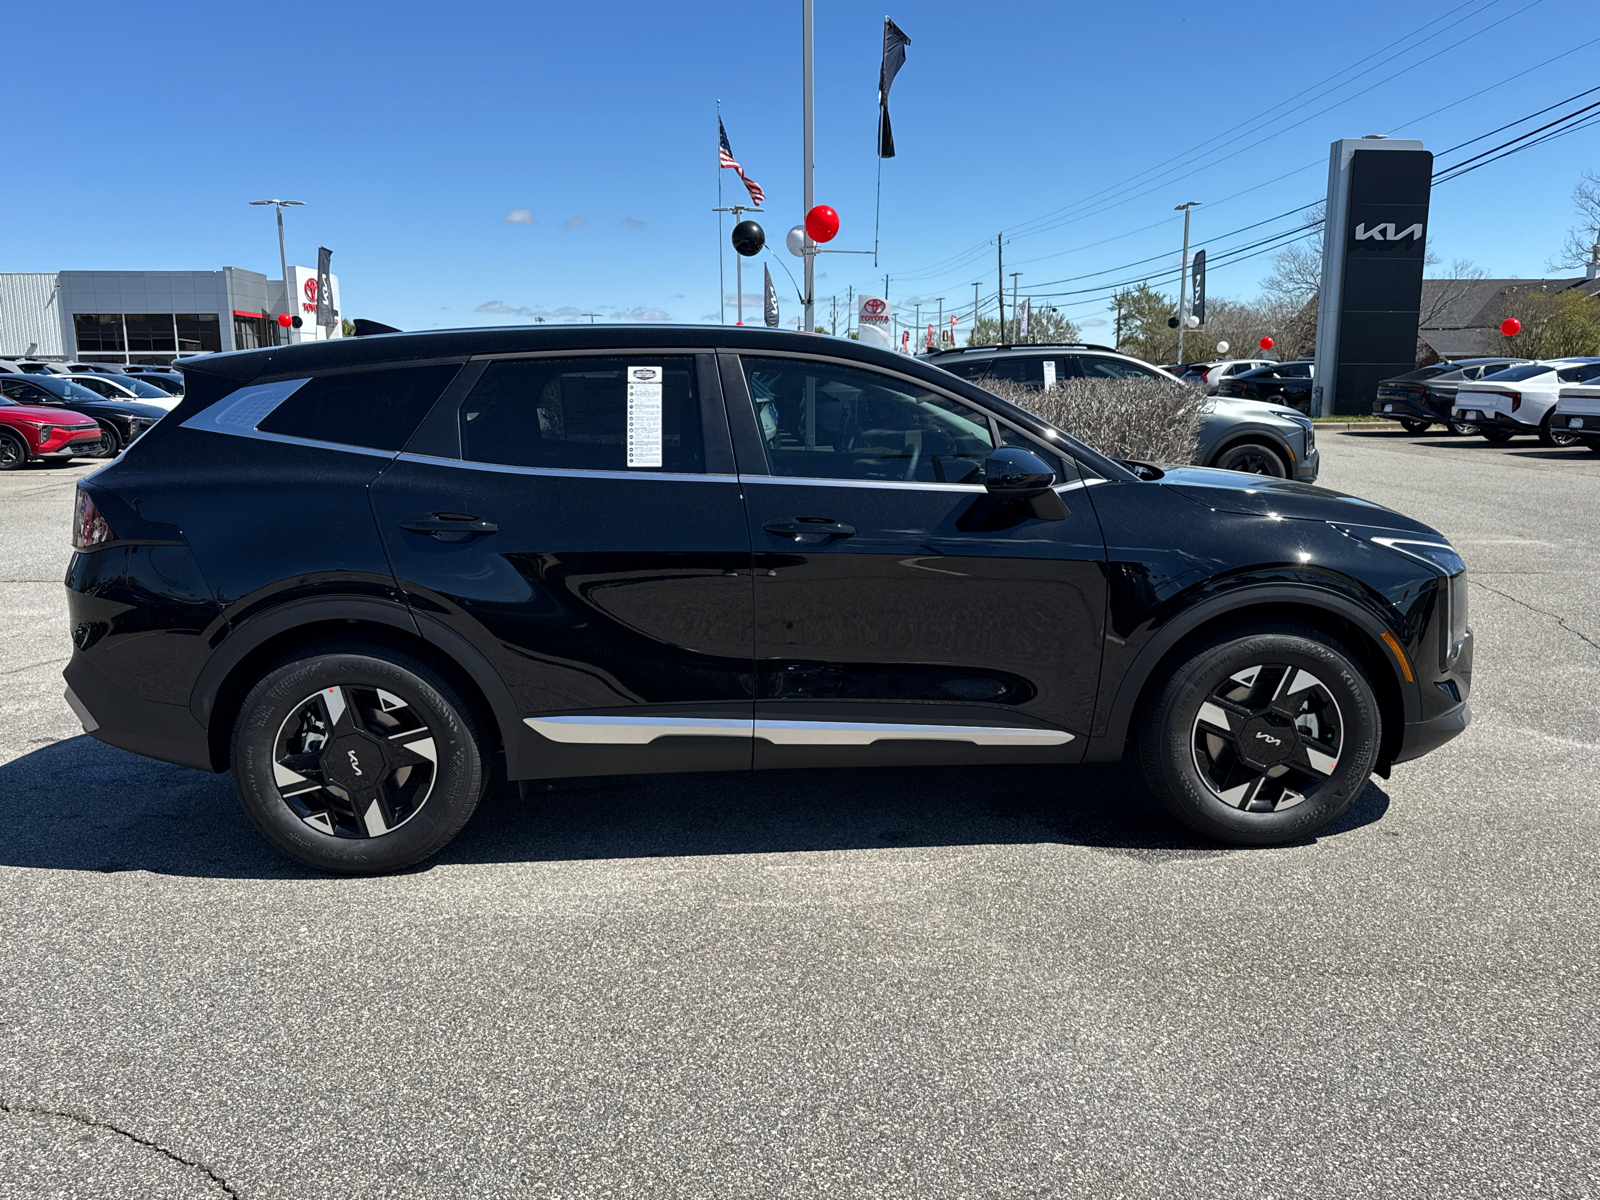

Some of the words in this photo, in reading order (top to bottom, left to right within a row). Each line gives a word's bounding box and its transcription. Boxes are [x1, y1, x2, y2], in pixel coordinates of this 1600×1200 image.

[860, 314, 889, 322] TOYOTA
[337, 660, 403, 682] KUMHO
[1340, 669, 1368, 726] KUMHO
